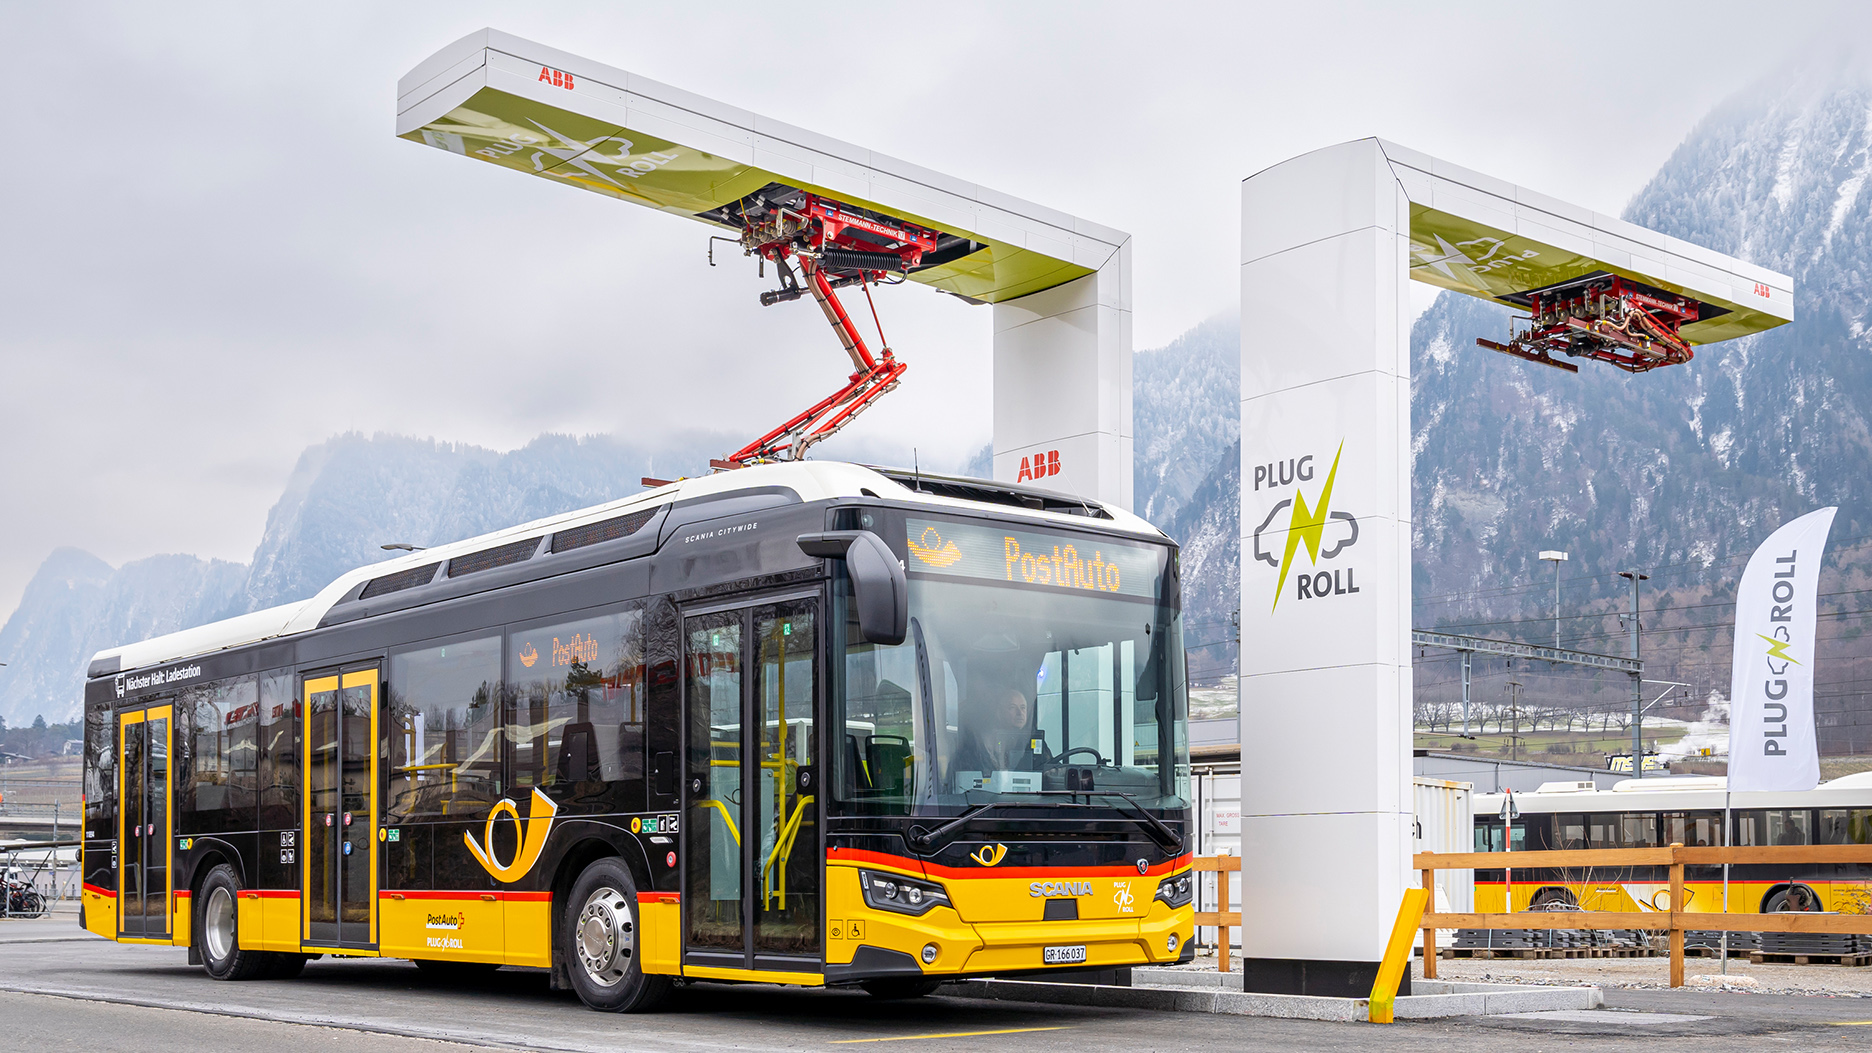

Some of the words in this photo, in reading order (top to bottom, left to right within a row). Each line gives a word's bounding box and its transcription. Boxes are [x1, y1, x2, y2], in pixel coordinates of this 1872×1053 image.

[538, 66, 575, 91] ABB
[475, 133, 539, 159] PLUG
[615, 151, 679, 178] ROLL
[838, 213, 898, 237] STEMMANN-TECHNIK
[1753, 282, 1771, 299] ABB
[1017, 449, 1061, 484] ABB
[1254, 454, 1314, 492] PLUG
[685, 531, 714, 544] SCANIA
[718, 522, 758, 536] CITYWIDE
[1004, 536, 1121, 592] PostAuto
[1297, 567, 1360, 601] ROLL
[1770, 549, 1797, 622] ROLL
[552, 633, 598, 667] PostAuto
[126, 675, 151, 691] Nächster
[166, 663, 201, 683] Ladestation
[1764, 680, 1788, 756] PLUG
[1029, 881, 1094, 898] SCANIA
[427, 913, 458, 926] PostAuto
[427, 937, 441, 948] PLUG
[450, 938, 463, 949] ROLL
